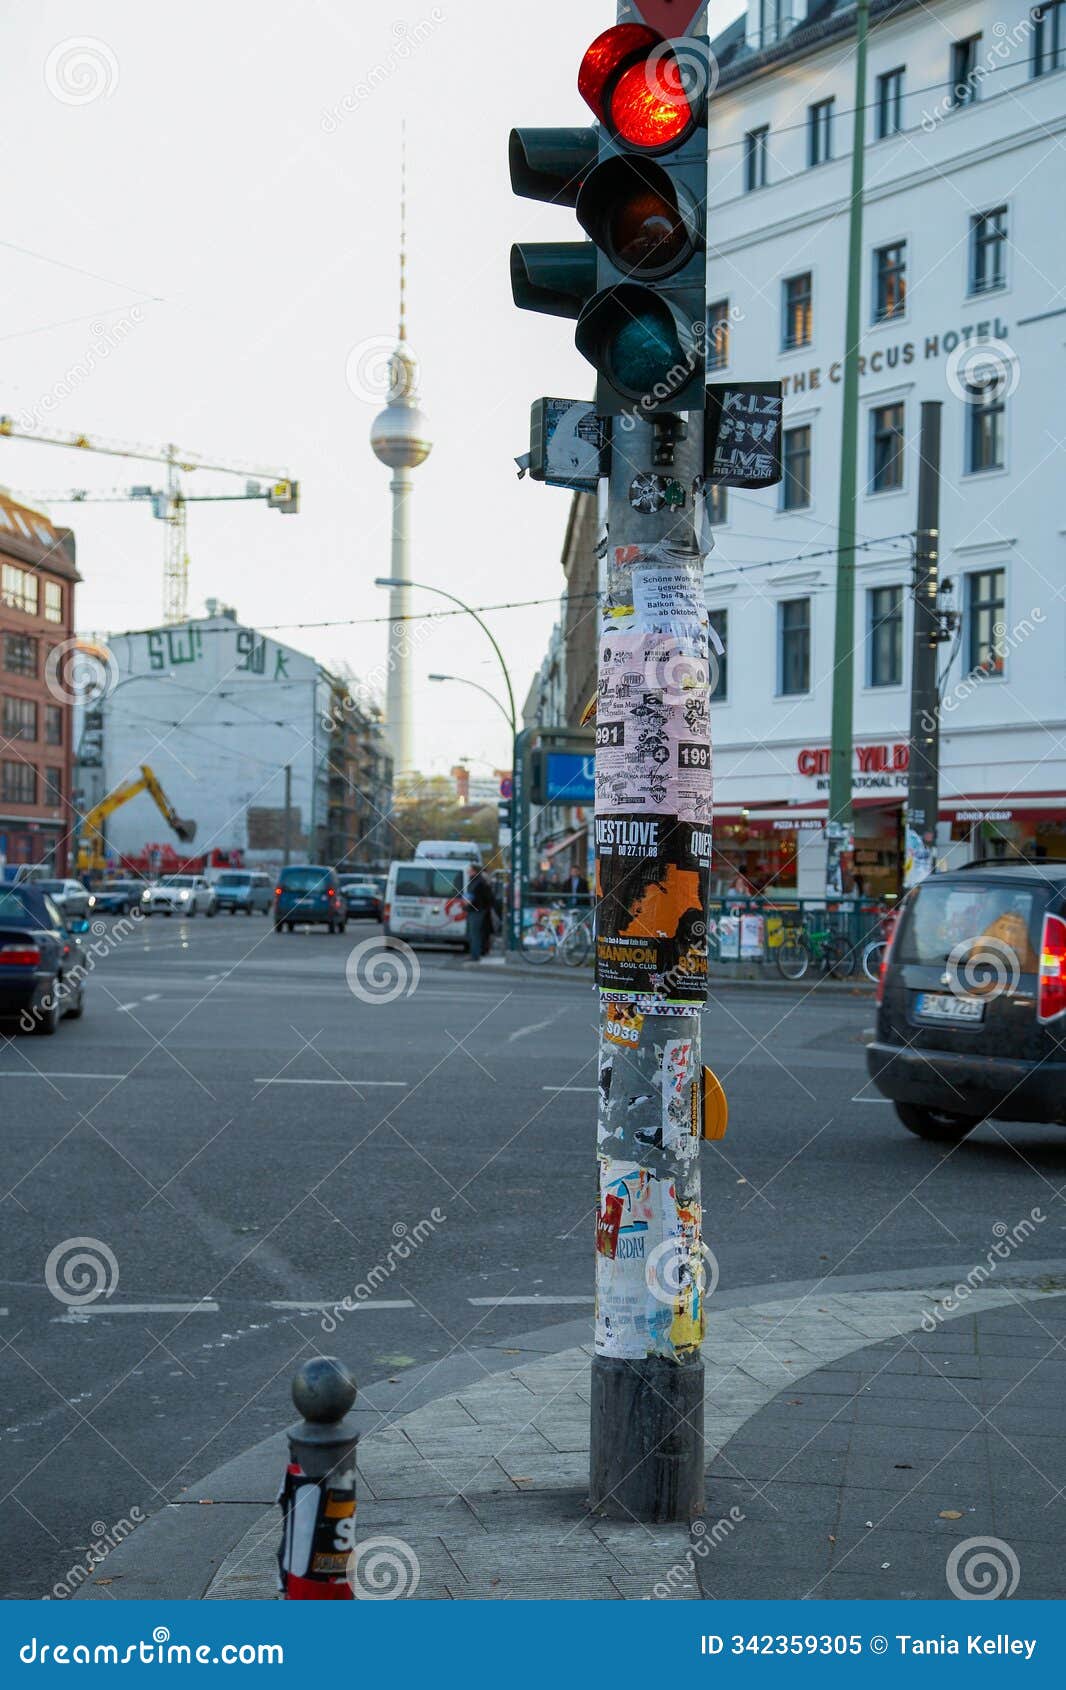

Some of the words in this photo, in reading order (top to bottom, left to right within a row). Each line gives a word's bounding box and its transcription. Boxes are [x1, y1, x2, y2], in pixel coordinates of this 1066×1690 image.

[782, 368, 821, 396] THE
[830, 343, 914, 383] CRCUS
[925, 317, 1008, 359] HOTEL
[714, 446, 775, 468] LIVE
[643, 575, 672, 584] Schöne
[596, 819, 658, 846] UESTLOVE
